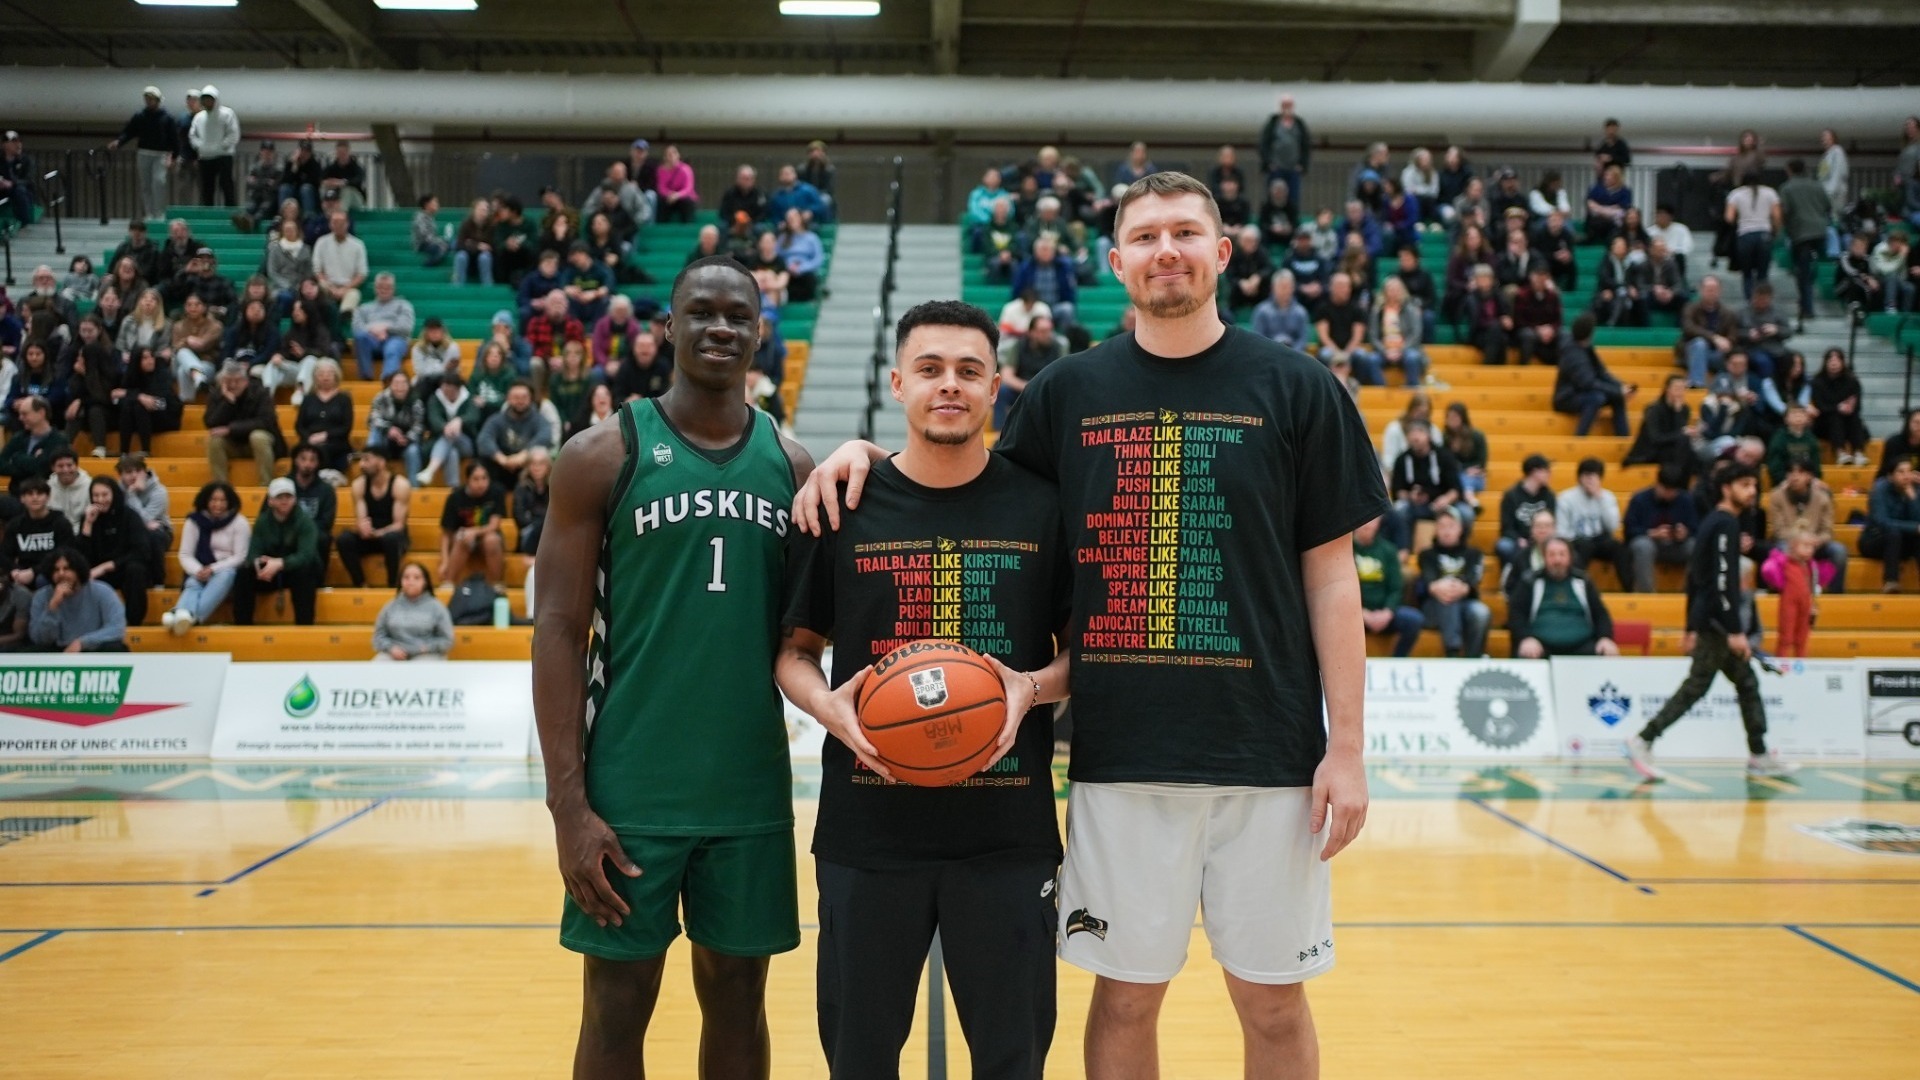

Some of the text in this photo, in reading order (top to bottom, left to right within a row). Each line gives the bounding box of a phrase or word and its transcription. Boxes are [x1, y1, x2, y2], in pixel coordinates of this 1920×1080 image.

[1081, 426, 1243, 447] TRAILBLAZE LIKE KIRSTINE
[656, 455, 671, 463] WEST
[1114, 443, 1216, 460] THINK LIKE SOILI
[1117, 460, 1210, 476] LEAD LIKE SAM
[1117, 477, 1215, 493] PUSH LIKE JOSH
[1113, 495, 1225, 511] BUILD LIKE SARAH
[634, 489, 790, 539] HUSKIES
[1086, 512, 1232, 529] DOMINATE LIKE FRANCO
[17, 532, 55, 552] VANS
[1098, 529, 1213, 546] BELIEVE LIKE TOFA
[856, 553, 1021, 573] TRAILBLAZE LIKE KIRSTINE
[1077, 546, 1221, 564] CHALLENGE LIKE MARIA
[707, 537, 727, 592] 1
[1102, 564, 1224, 581] INSPIRE LIKE JAMES
[893, 570, 996, 586] THINK LIKE SOILI
[899, 587, 990, 603] LEAD LIKE SAM
[1108, 581, 1214, 598] SPEAK LIKE ABOU
[899, 604, 995, 620] PUSH LIKE JOSH
[1107, 598, 1228, 616] DREAM LIKE ADAIAH
[895, 621, 1005, 637] BUILD LIKE SARAH
[1088, 616, 1228, 634] ADVOCATE LIKE TYRELL
[963, 639, 1012, 655] FRANCO
[1083, 633, 1240, 652] PERSEVERE LIKE NYEMUON
[873, 642, 970, 676] Wilson
[0, 670, 121, 694] OLLING MIX
[1367, 664, 1437, 694] Ltd.
[1873, 675, 1907, 688] Proud
[915, 681, 945, 695] SPORTS
[329, 688, 465, 709] TIDEWATER
[61, 739, 77, 750] OF
[82, 739, 117, 750] UNBC
[120, 738, 187, 750] ATHLETICS
